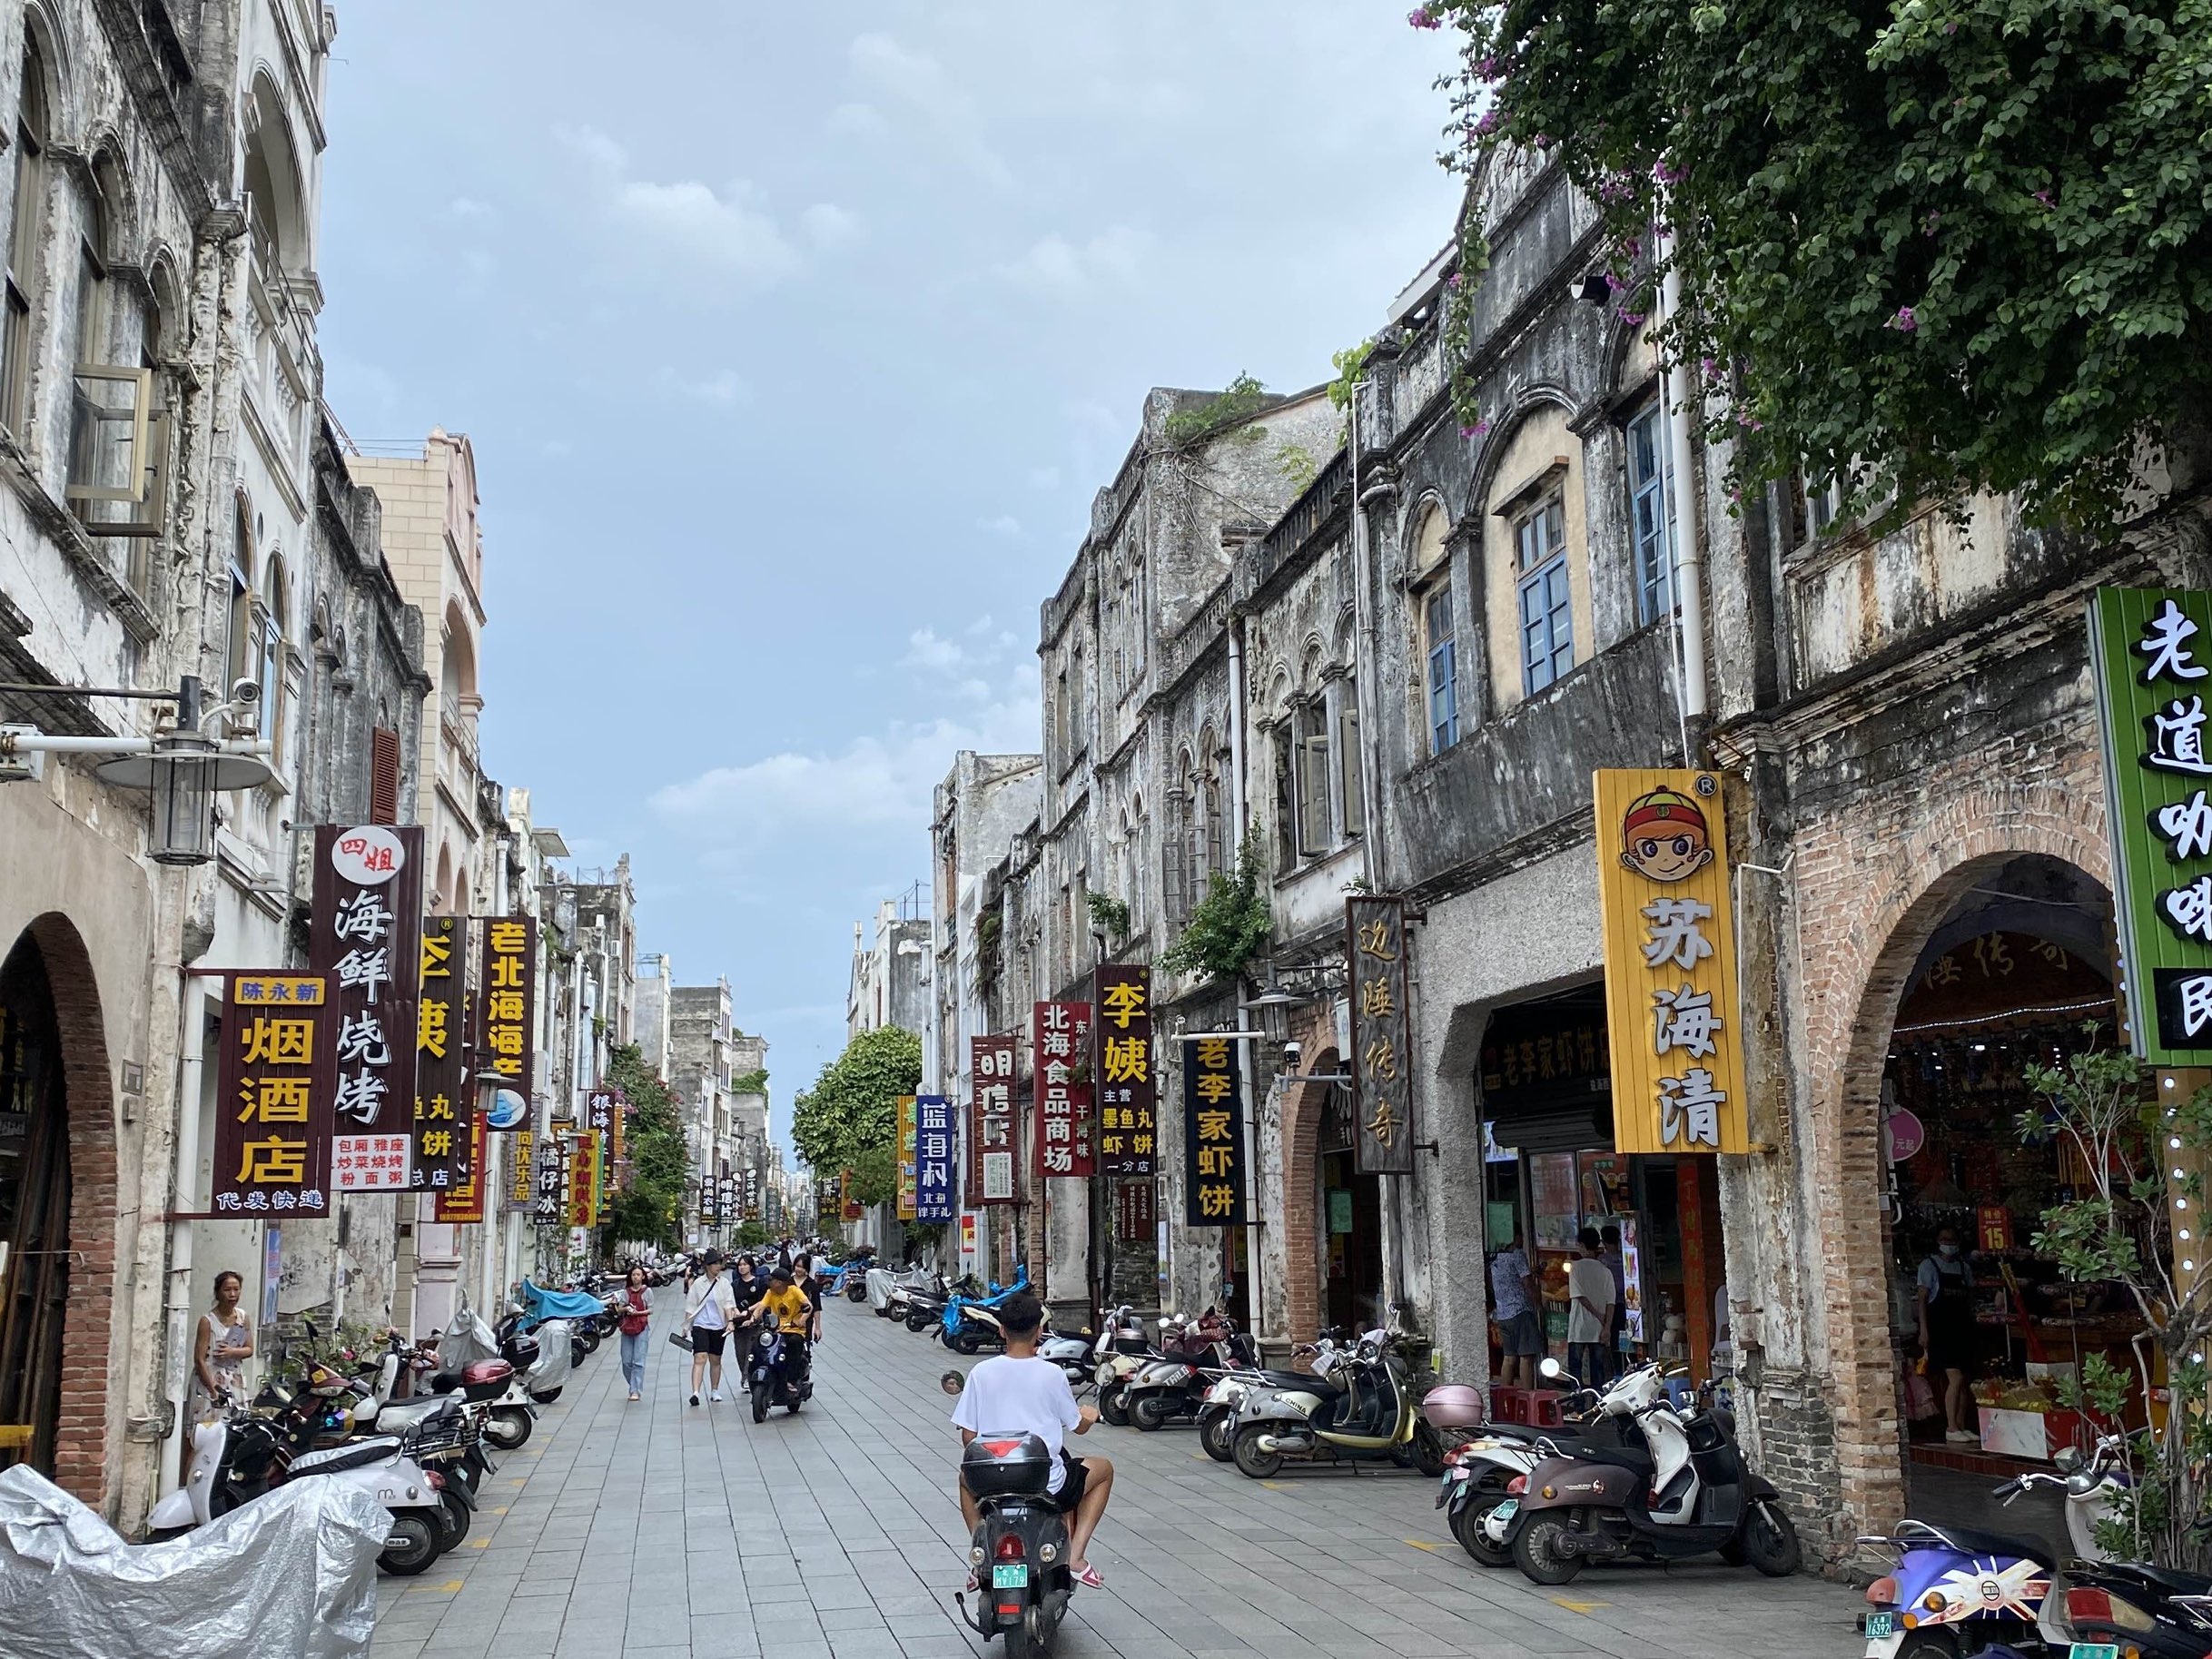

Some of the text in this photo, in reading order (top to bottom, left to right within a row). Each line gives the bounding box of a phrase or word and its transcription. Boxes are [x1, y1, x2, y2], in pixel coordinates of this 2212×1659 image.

[339, 836, 397, 873] 四姐
[241, 982, 320, 1002] 陈永新
[333, 889, 394, 1126] 海鲜烧烤
[1102, 982, 1149, 1083] 李姨
[1641, 898, 1725, 1147] 苏海清
[1358, 919, 1404, 1151] 边陲传奇
[1041, 1004, 1072, 1172] 北海食品商场
[1103, 1089, 1131, 1103] 主营
[234, 1019, 314, 1184] 烟酒店
[1101, 1107, 1153, 1130] 墨鱼丸
[1197, 1039, 1235, 1217] 老李家虾饼
[338, 1139, 405, 1153] 包厢雅座
[922, 1102, 948, 1188] 蓝海叔
[1102, 1134, 1153, 1156] 虾饼
[337, 1154, 404, 1170] 炒菜烧烤
[1106, 1160, 1150, 1172] 一分店
[340, 1170, 403, 1186] 粉面粥
[216, 1190, 324, 1211] 代发快递
[923, 1192, 946, 1204] 北海
[917, 1206, 952, 1219] 伴手礼
[1984, 1227, 2004, 1249] 15
[1285, 1397, 1307, 1414] CHINA
[1868, 1623, 1890, 1635] 16392
